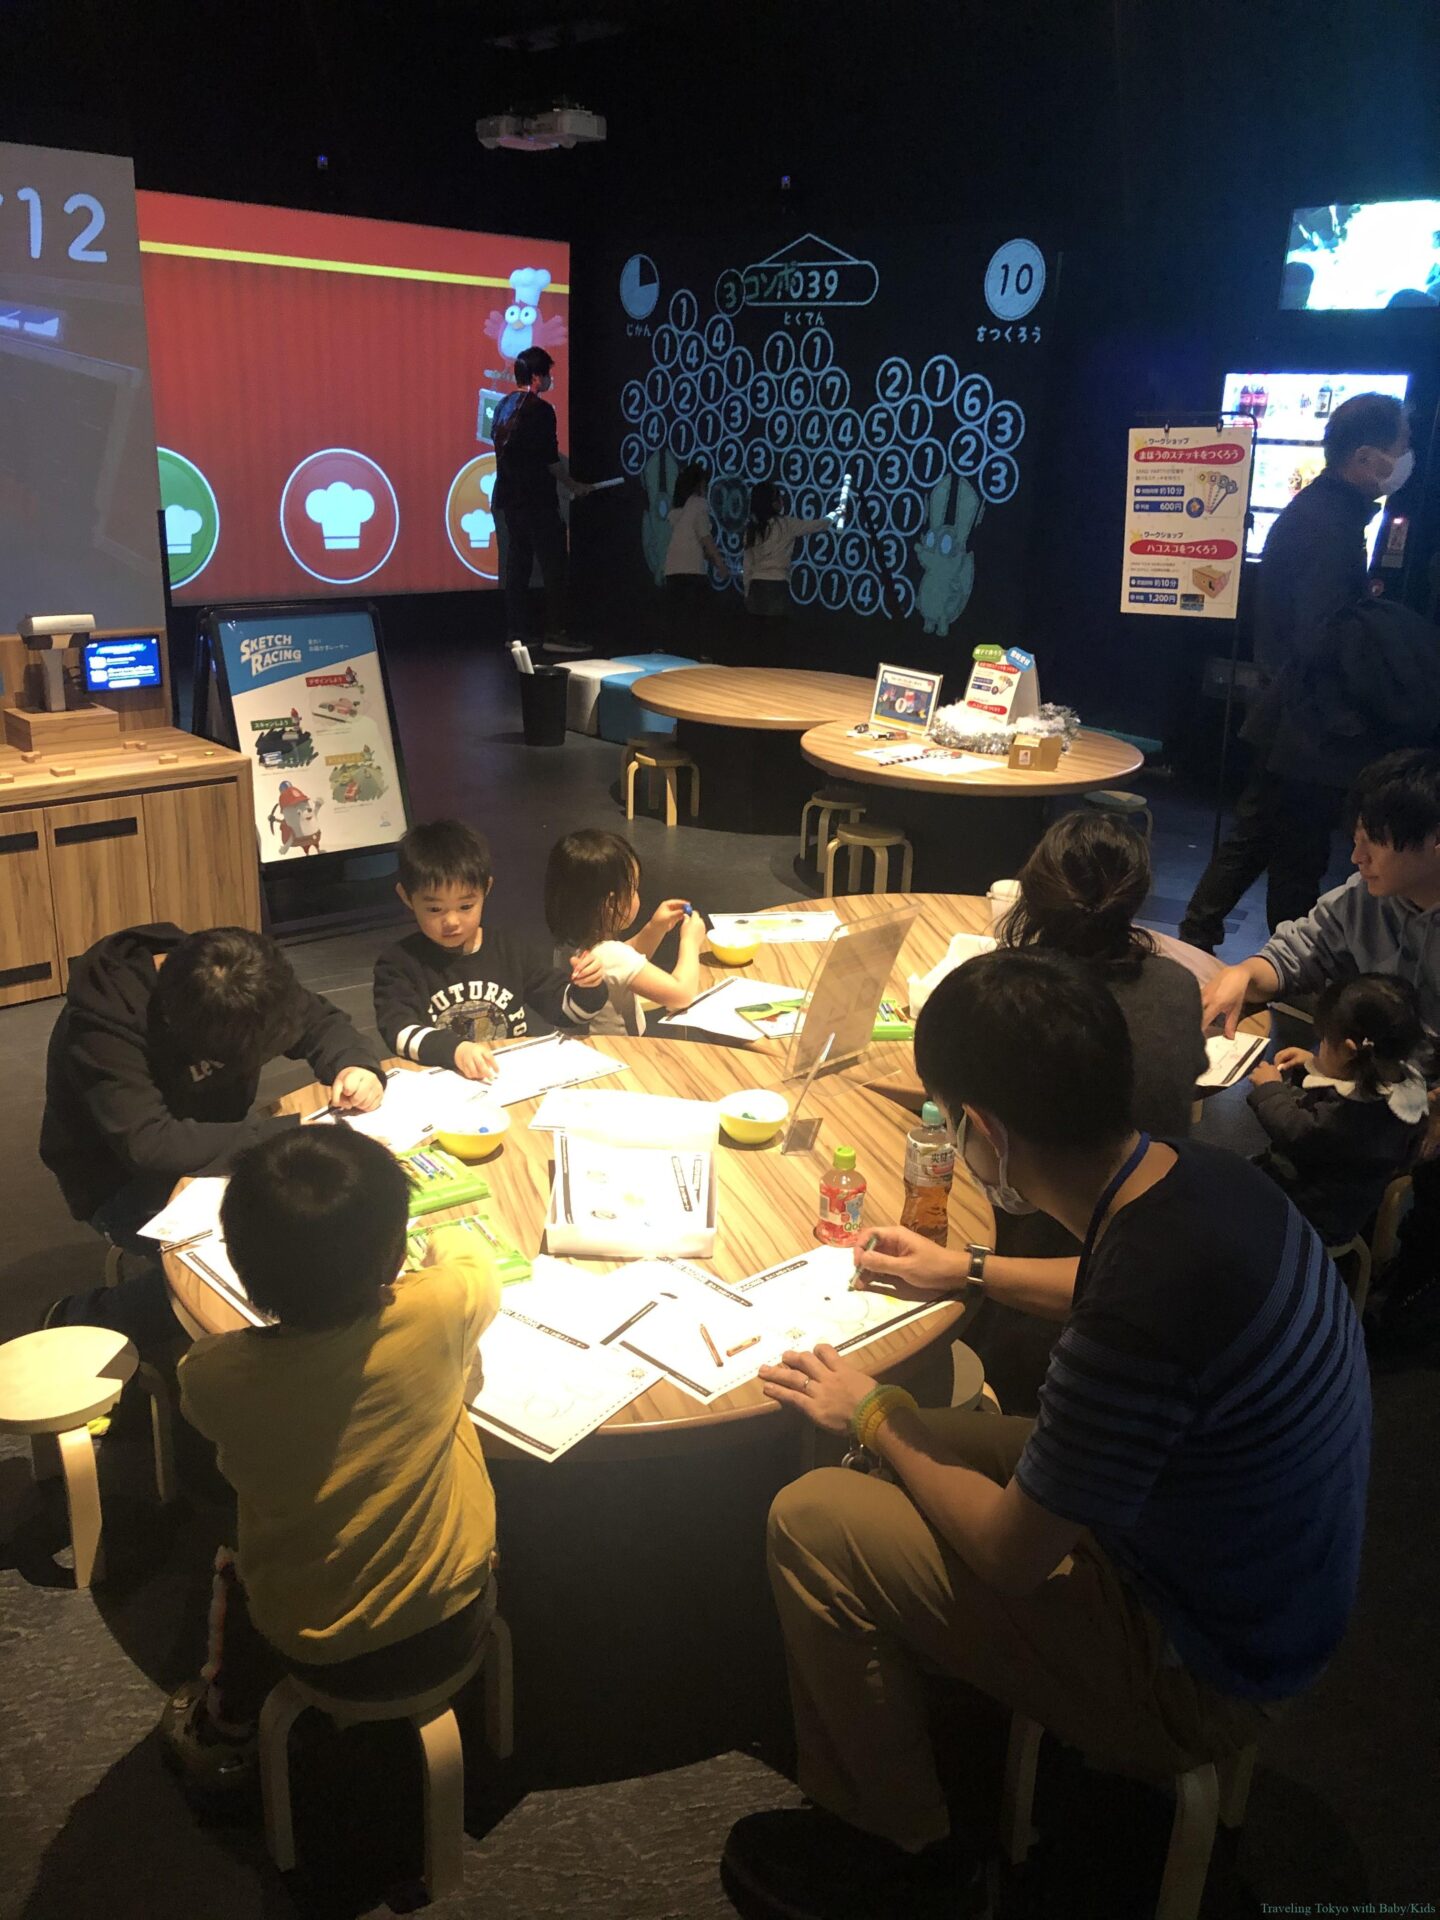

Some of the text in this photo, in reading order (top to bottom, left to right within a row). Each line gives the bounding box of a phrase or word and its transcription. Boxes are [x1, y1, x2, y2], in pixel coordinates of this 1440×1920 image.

[1001, 263, 1033, 296] 10
[724, 282, 737, 308] 3
[680, 297, 688, 327] 1
[783, 311, 825, 326] とくてん
[663, 332, 670, 361] 1
[712, 322, 726, 352] 4
[976, 325, 1041, 344] をつくろう
[686, 340, 700, 368] 4
[775, 340, 784, 371] 1
[813, 335, 822, 368] 1
[735, 354, 743, 384] 1
[885, 366, 902, 398] 2
[935, 364, 946, 398] 1
[656, 373, 662, 402] 1
[679, 381, 691, 410] 2
[708, 371, 716, 400] 1
[756, 380, 769, 409] 3
[790, 376, 805, 407] 6
[825, 375, 841, 406] 7
[628, 388, 640, 415] 2
[729, 400, 742, 428] 3
[963, 383, 981, 418] 6
[647, 415, 660, 443] 4
[706, 414, 713, 443] 1
[774, 415, 788, 444] 9
[805, 414, 821, 445] 4
[838, 417, 854, 447] 4
[871, 412, 887, 442] 5
[910, 403, 920, 436] 1
[994, 410, 1014, 443] 3
[679, 423, 686, 452] 1
[958, 434, 977, 467] 2
[1148, 437, 1190, 445] ワークショップ
[627, 441, 640, 468] 2
[724, 443, 737, 471] 2
[752, 446, 766, 473] 3
[789, 453, 803, 481] 3
[924, 446, 934, 479] 1
[820, 455, 835, 484] 2
[856, 458, 864, 488] 1
[884, 454, 901, 485] 3
[989, 461, 1008, 494] 3
[902, 497, 911, 528] 1
[1160, 503, 1182, 511] 600円
[814, 533, 829, 562] 2
[845, 537, 860, 566] 6
[883, 539, 897, 568] 3
[1146, 544, 1218, 554] ハコスコをつくろう
[800, 569, 808, 597] 1
[831, 573, 838, 601] 1
[857, 578, 872, 607] 4
[240, 634, 292, 663] SKETCH
[251, 649, 302, 677] RACING
